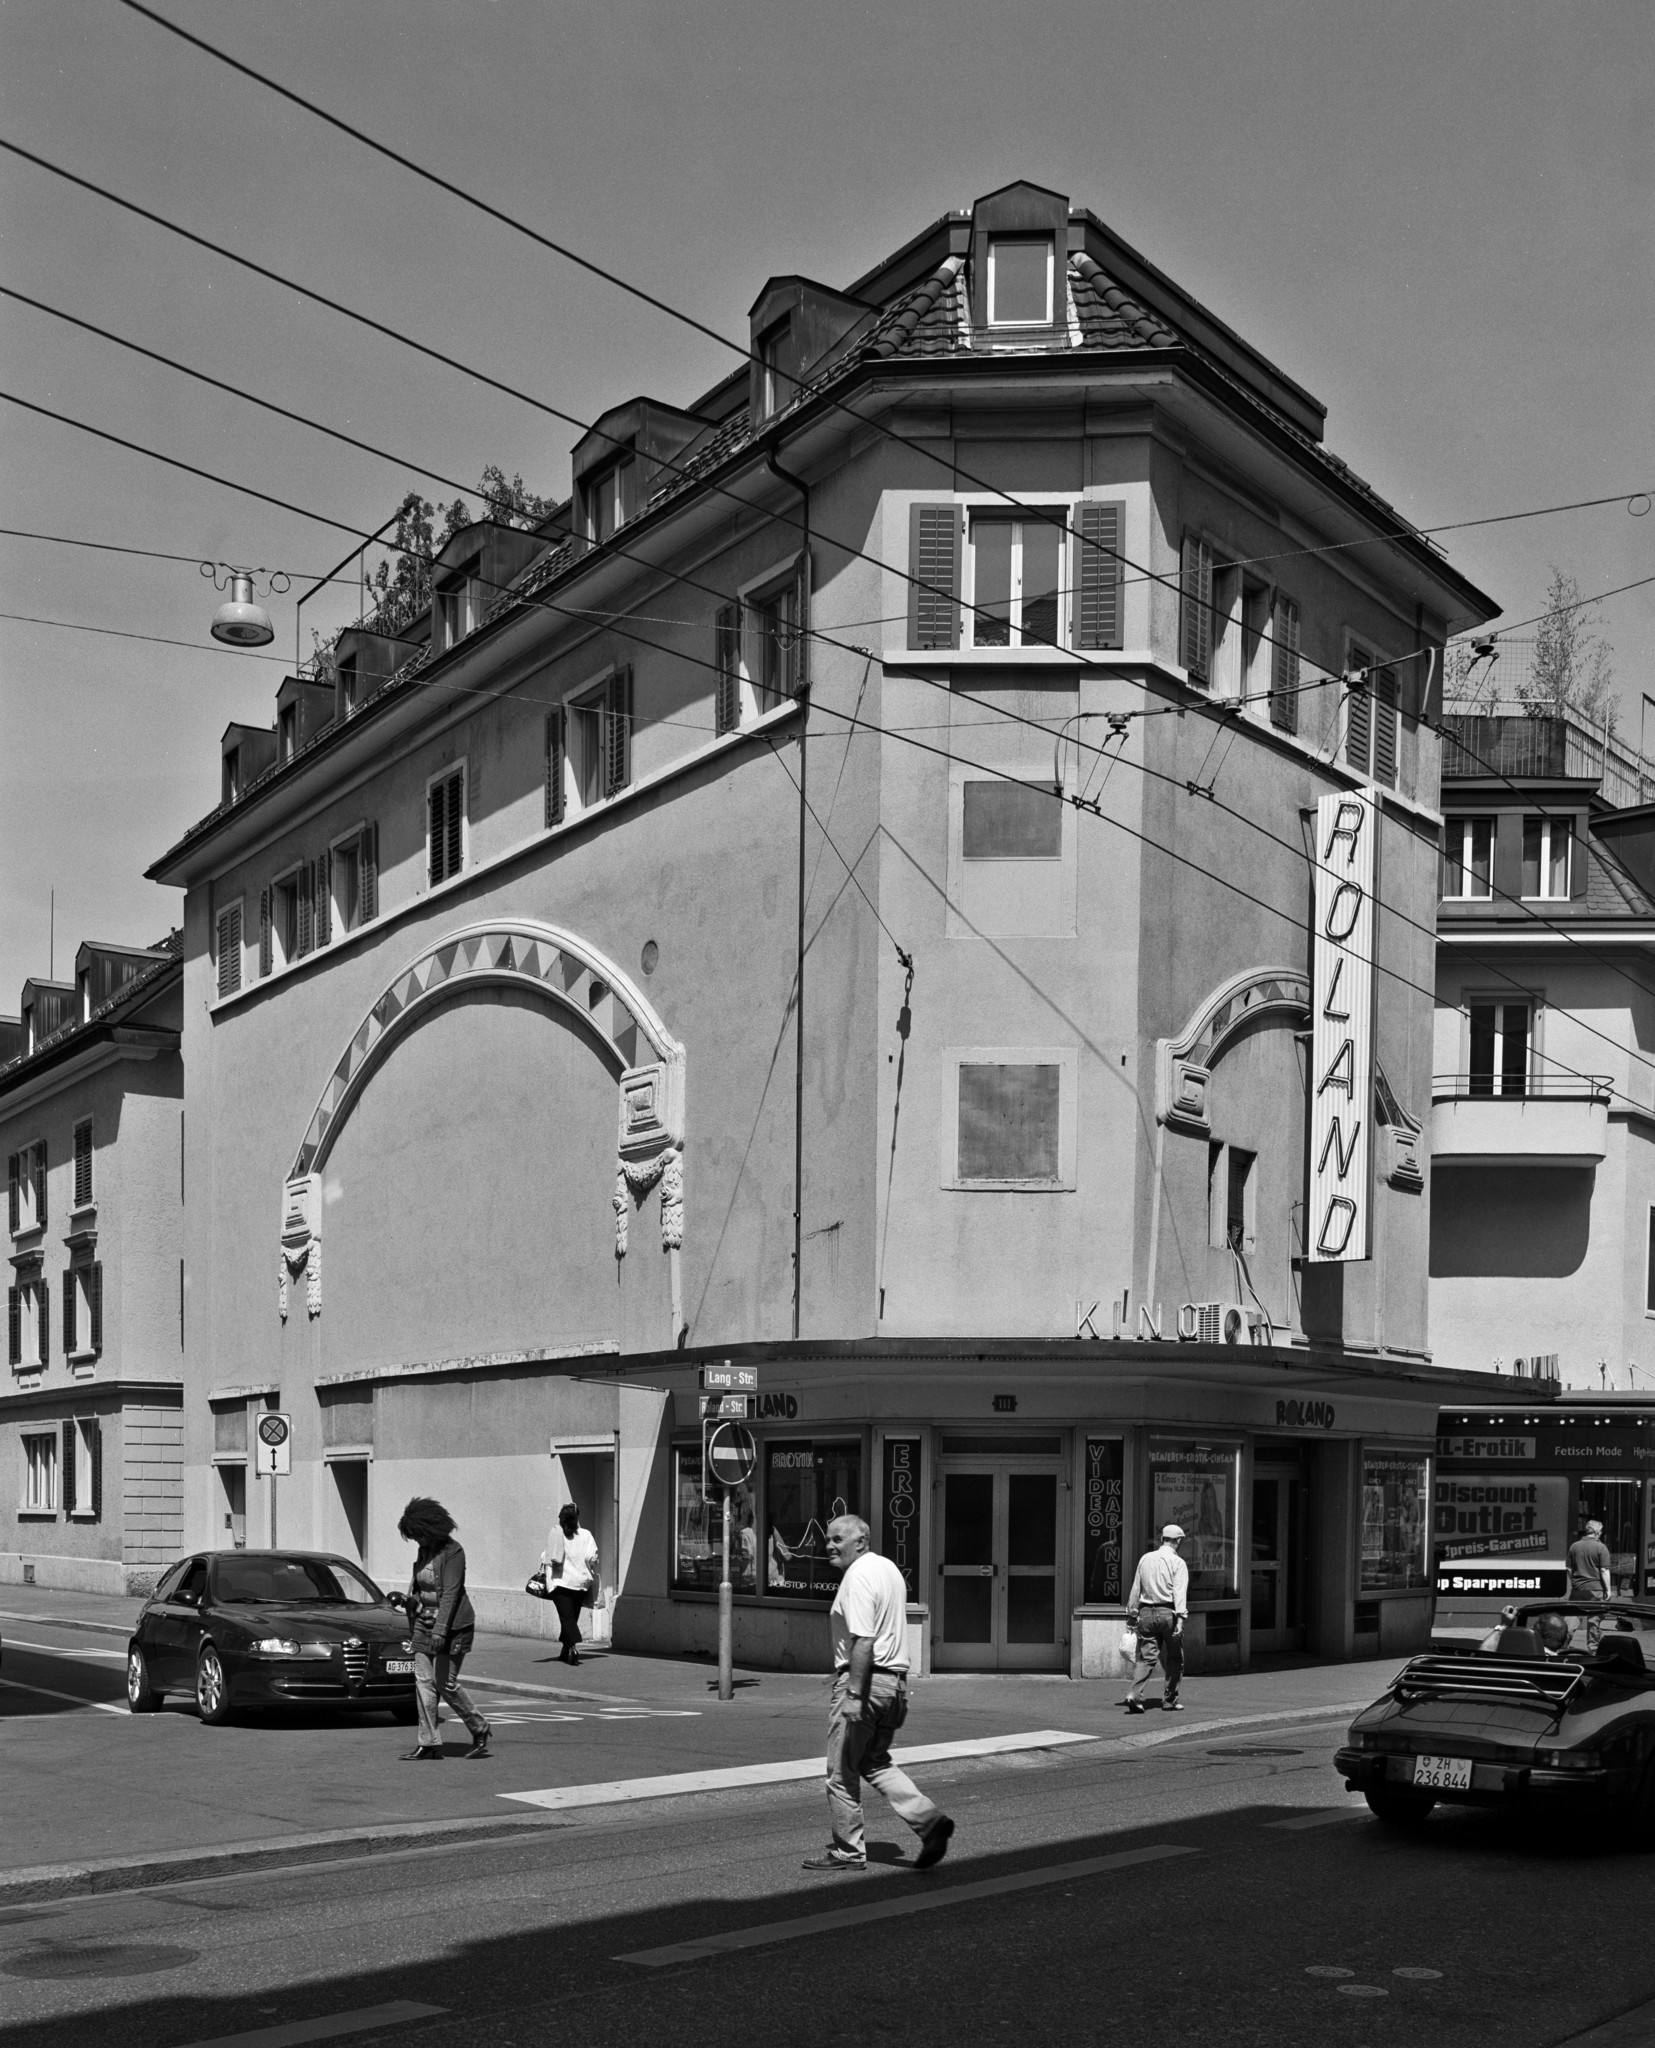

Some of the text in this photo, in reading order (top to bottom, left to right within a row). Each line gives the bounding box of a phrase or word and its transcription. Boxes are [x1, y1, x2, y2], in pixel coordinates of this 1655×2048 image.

[1316, 800, 1365, 1256] ROLAND
[1075, 1301, 1199, 1340] KINO
[708, 1371, 731, 1386] Lang
[701, 1400, 724, 1414] Roland
[756, 1393, 798, 1419] LAND
[1276, 1400, 1335, 1429] ROLAND
[772, 1452, 814, 1468] EROTIK
[1555, 1446, 1623, 1457] Fetisch Mode
[1161, 1473, 1176, 1483] Kinos
[1435, 1484, 1537, 1503] Discount
[1434, 1506, 1537, 1534] Outlet
[1104, 1479, 1121, 1597] KABINEN
[1453, 1576, 1541, 1591] Sparpreise!
[1436, 1758, 1451, 1770] ZH
